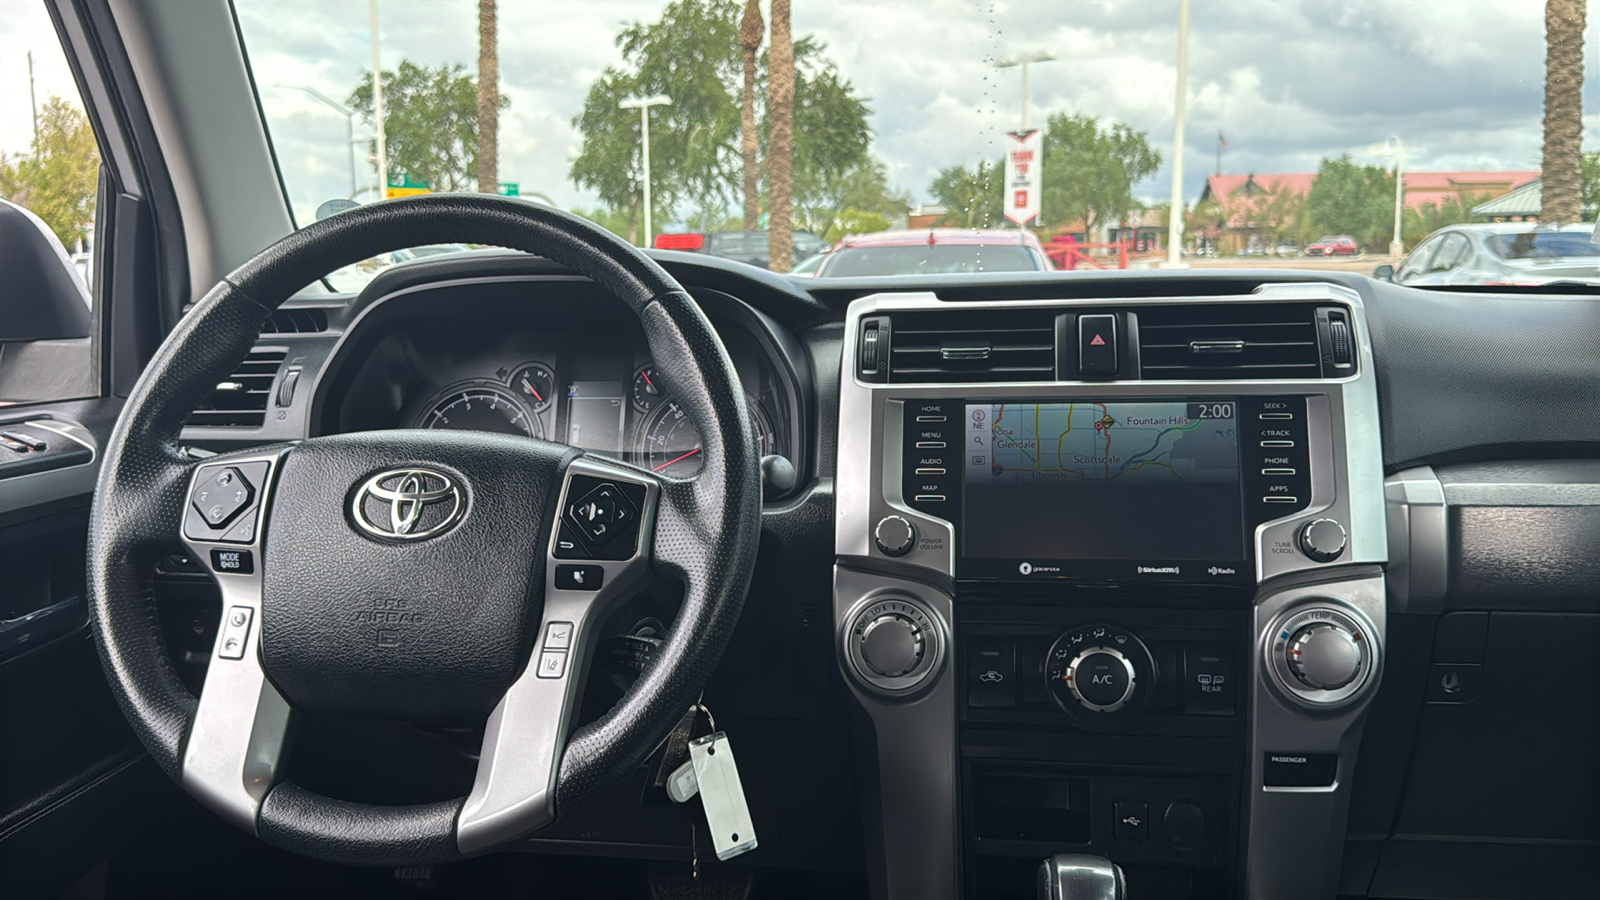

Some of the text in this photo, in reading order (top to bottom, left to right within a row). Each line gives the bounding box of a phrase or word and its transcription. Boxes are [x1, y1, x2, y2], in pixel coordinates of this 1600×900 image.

[1199, 404, 1231, 418] 2:00
[1126, 416, 1189, 425] Fountain Hills
[973, 422, 984, 430] NE
[657, 435, 665, 445] 20
[997, 440, 1036, 449] Glendale
[1073, 455, 1120, 464] Scottsdale
[219, 552, 240, 561] MODE
[373, 599, 408, 610] SRS
[355, 610, 426, 622] AIRBAG
[870, 606, 882, 616] LO
[860, 615, 870, 628] OFF
[922, 622, 931, 631] HI
[1092, 675, 1113, 685] A/C
